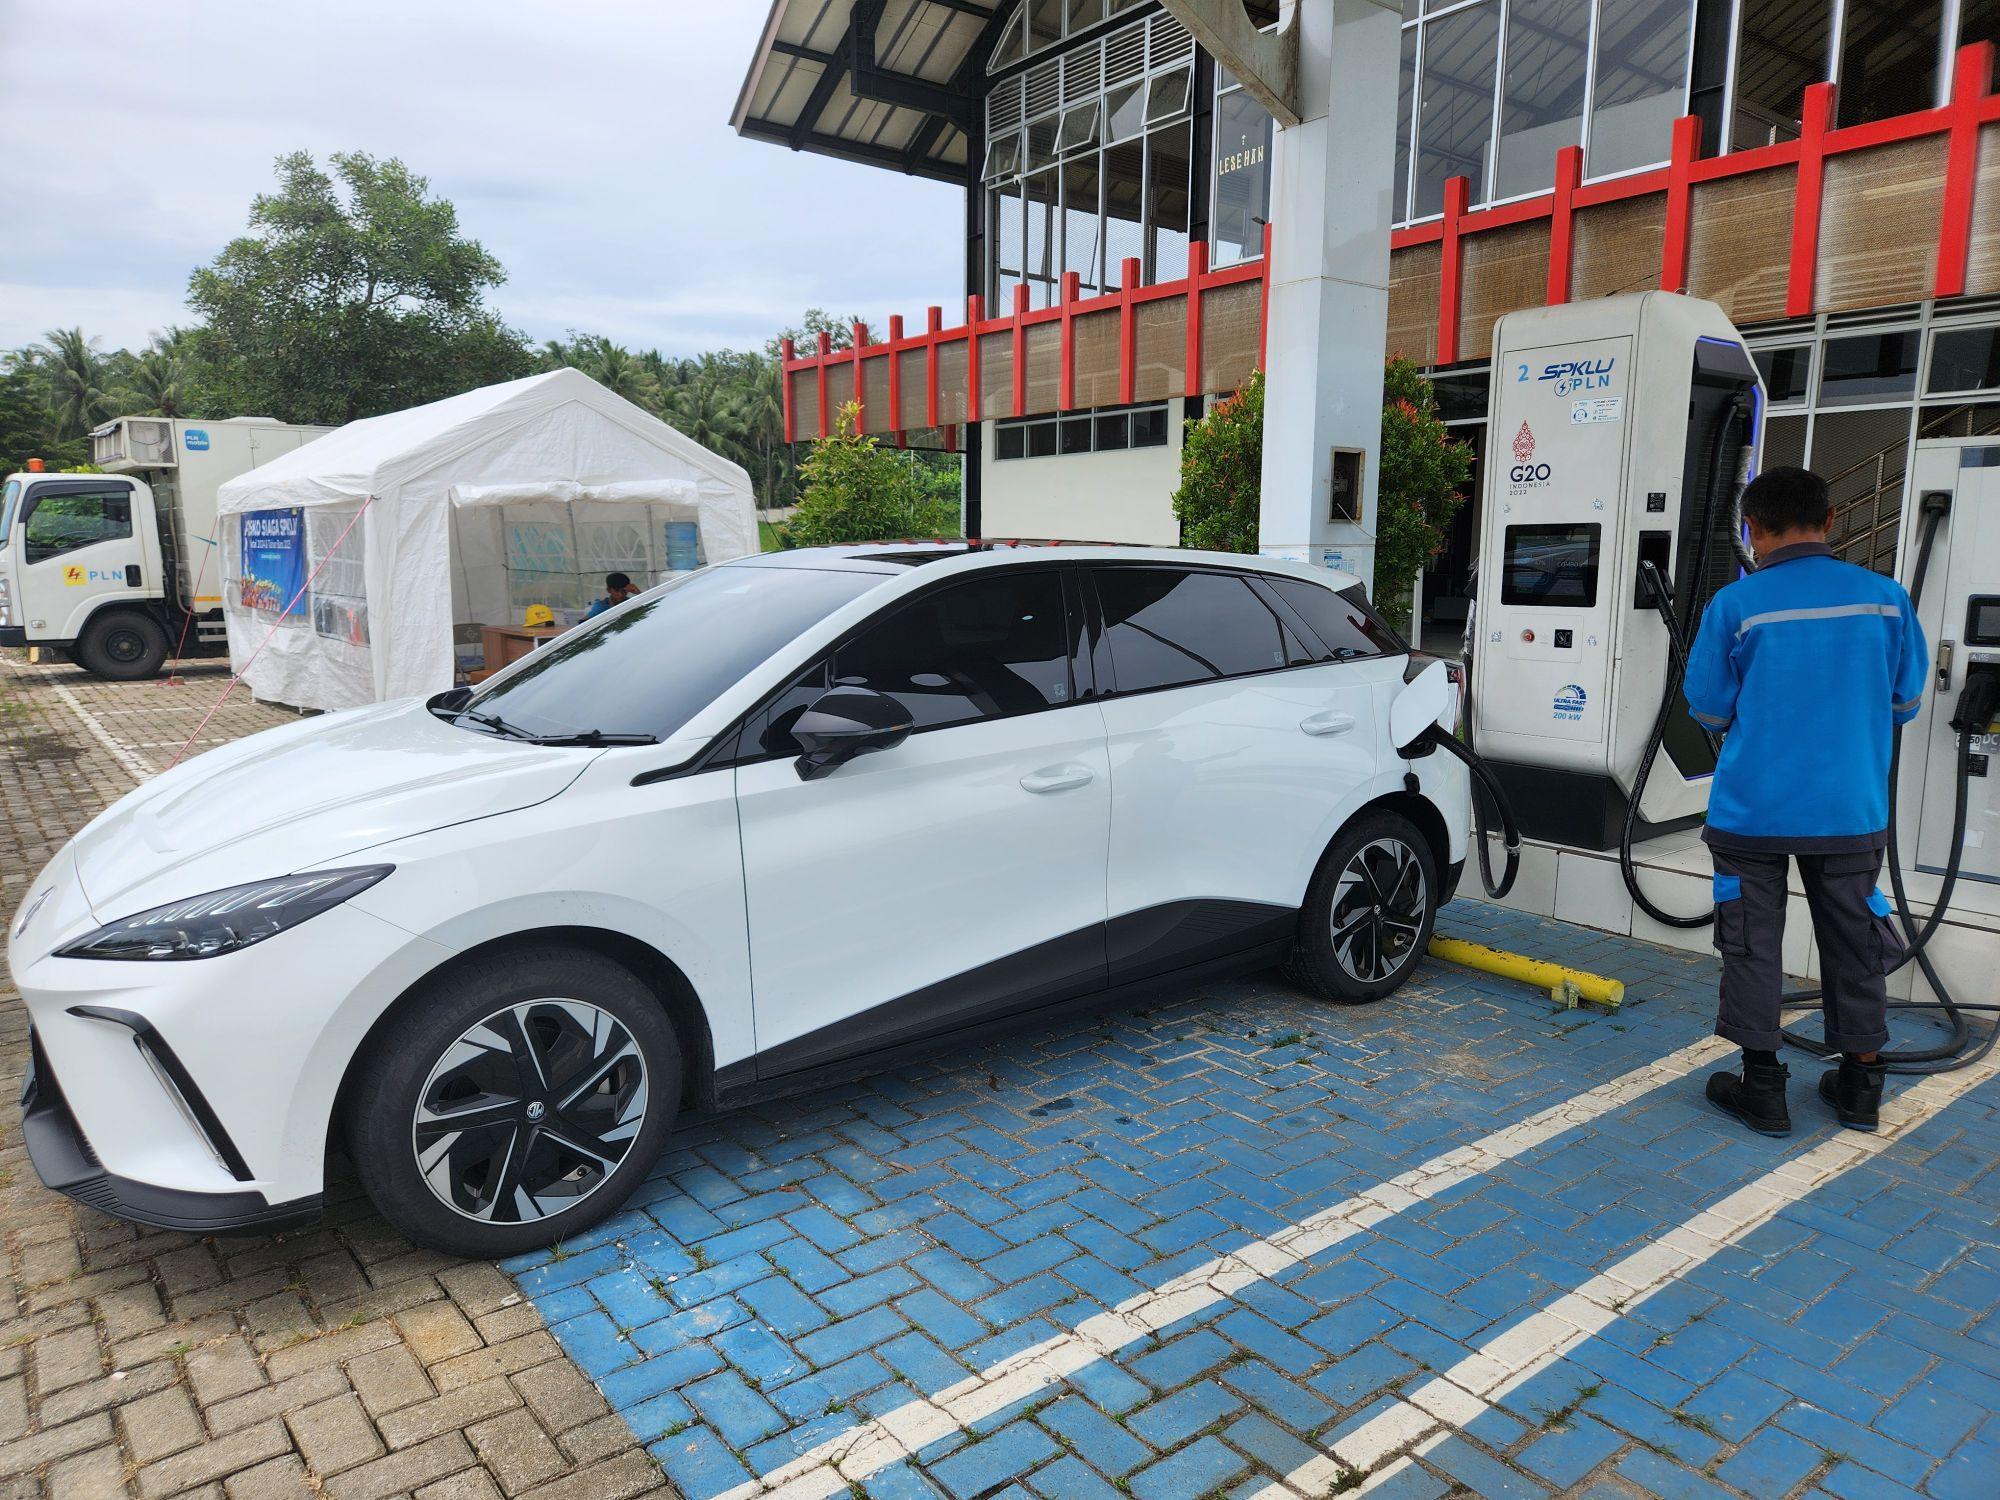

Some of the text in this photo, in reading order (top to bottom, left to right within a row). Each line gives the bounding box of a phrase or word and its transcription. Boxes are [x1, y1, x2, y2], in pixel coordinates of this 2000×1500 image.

[1218, 145, 1264, 175] LESEHAN
[1518, 364, 1529, 382] 2
[1538, 358, 1615, 381] SPKLU
[1572, 374, 1610, 391] PLN
[1510, 463, 1551, 482] G20
[1509, 481, 1551, 489] INDONESIA
[89, 571, 123, 580] PLN
[1553, 712, 1567, 720] 200
